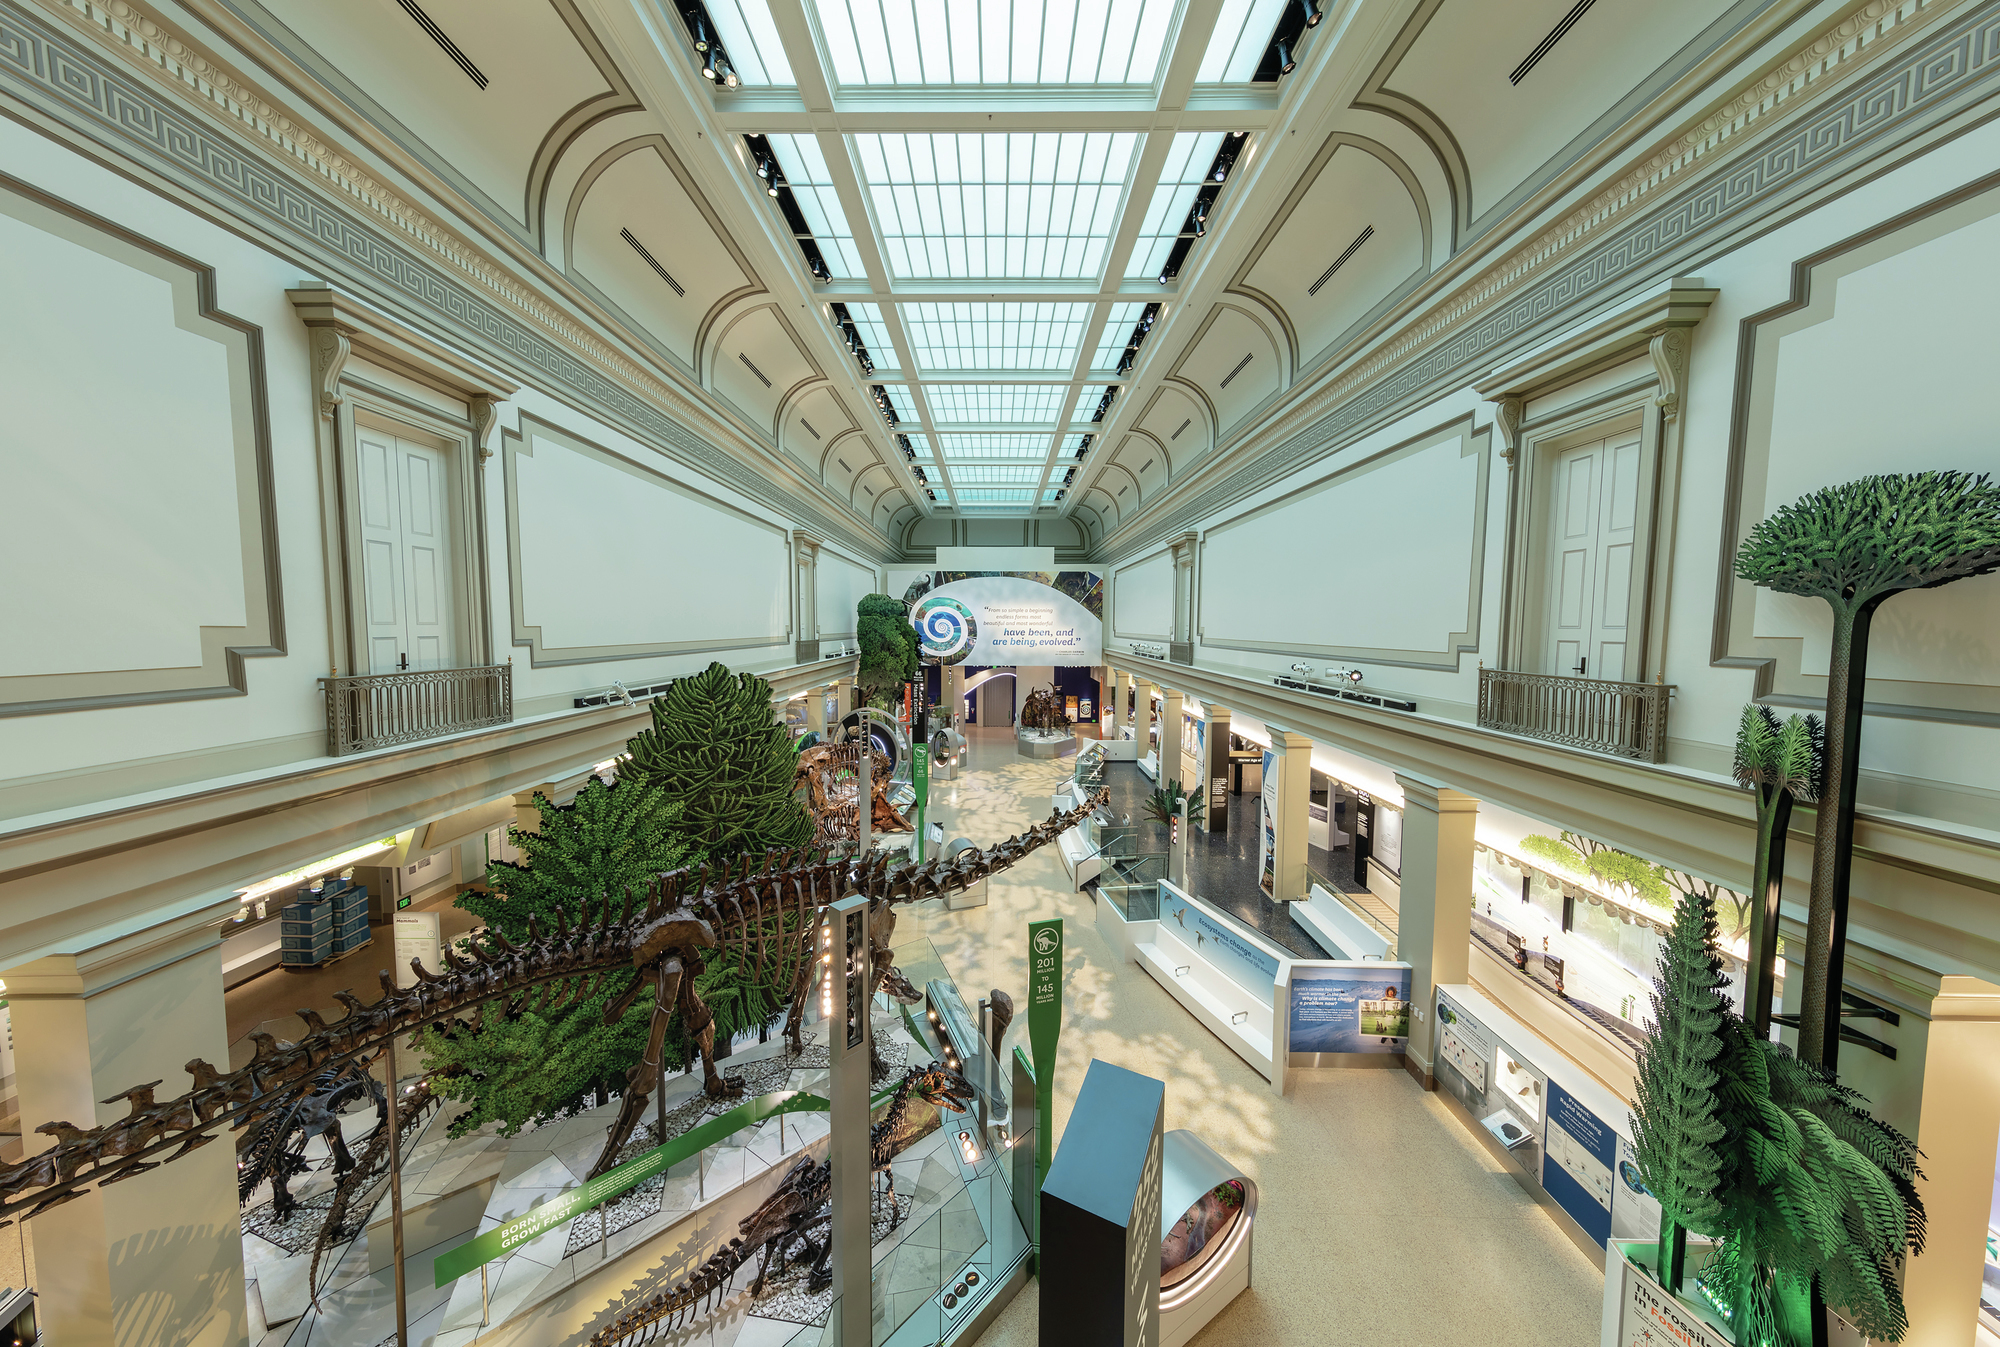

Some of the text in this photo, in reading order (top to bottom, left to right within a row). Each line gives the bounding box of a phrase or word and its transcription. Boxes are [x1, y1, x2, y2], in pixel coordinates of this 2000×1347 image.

[1004, 628, 1074, 637] have been, and
[1010, 638, 1037, 647] being,
[1039, 638, 1081, 646] evolved.”
[1198, 918, 1229, 942] Ecosystems
[1230, 939, 1252, 957] change
[1037, 957, 1054, 968] 201
[1037, 983, 1053, 994] 145
[1560, 1097, 1575, 1113] Rapid
[1576, 1110, 1602, 1137] Warming
[1568, 1097, 1592, 1120] Present:
[1134, 1134, 1159, 1240] 252
[501, 1195, 581, 1238] BORN SMALL,
[501, 1206, 572, 1248] GROW FAST
[1634, 1281, 1659, 1308] The
[1634, 1291, 1646, 1309] in
